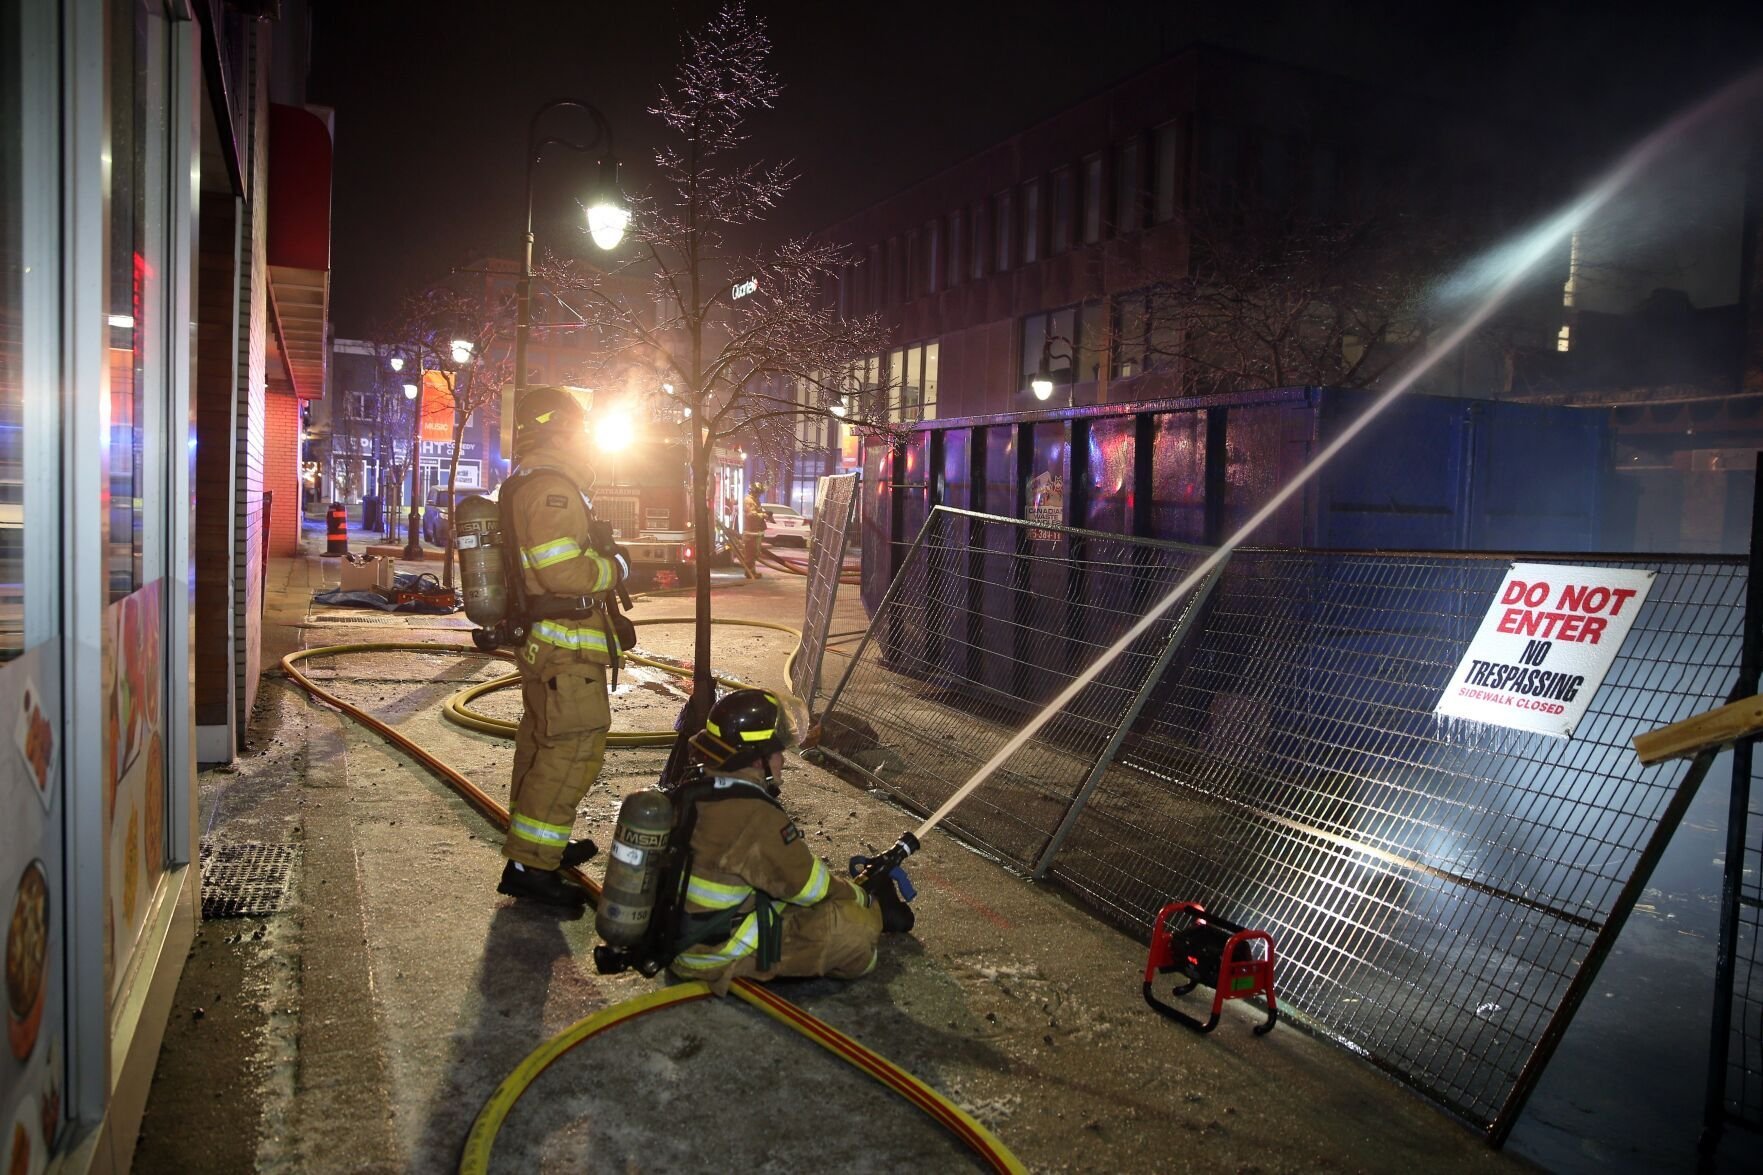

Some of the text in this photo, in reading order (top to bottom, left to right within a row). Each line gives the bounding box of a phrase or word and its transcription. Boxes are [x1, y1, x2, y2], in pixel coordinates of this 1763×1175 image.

[424, 423, 448, 431] MUSIC
[446, 441, 475, 450] COEDY
[1501, 580, 1637, 616] DO NOT
[1496, 608, 1608, 644] ENTER
[1518, 639, 1552, 666] NO
[1464, 659, 1584, 702] TRESPASSING
[1458, 688, 1564, 715] SIDEWALK CLOSED
[625, 831, 658, 846] MSA
